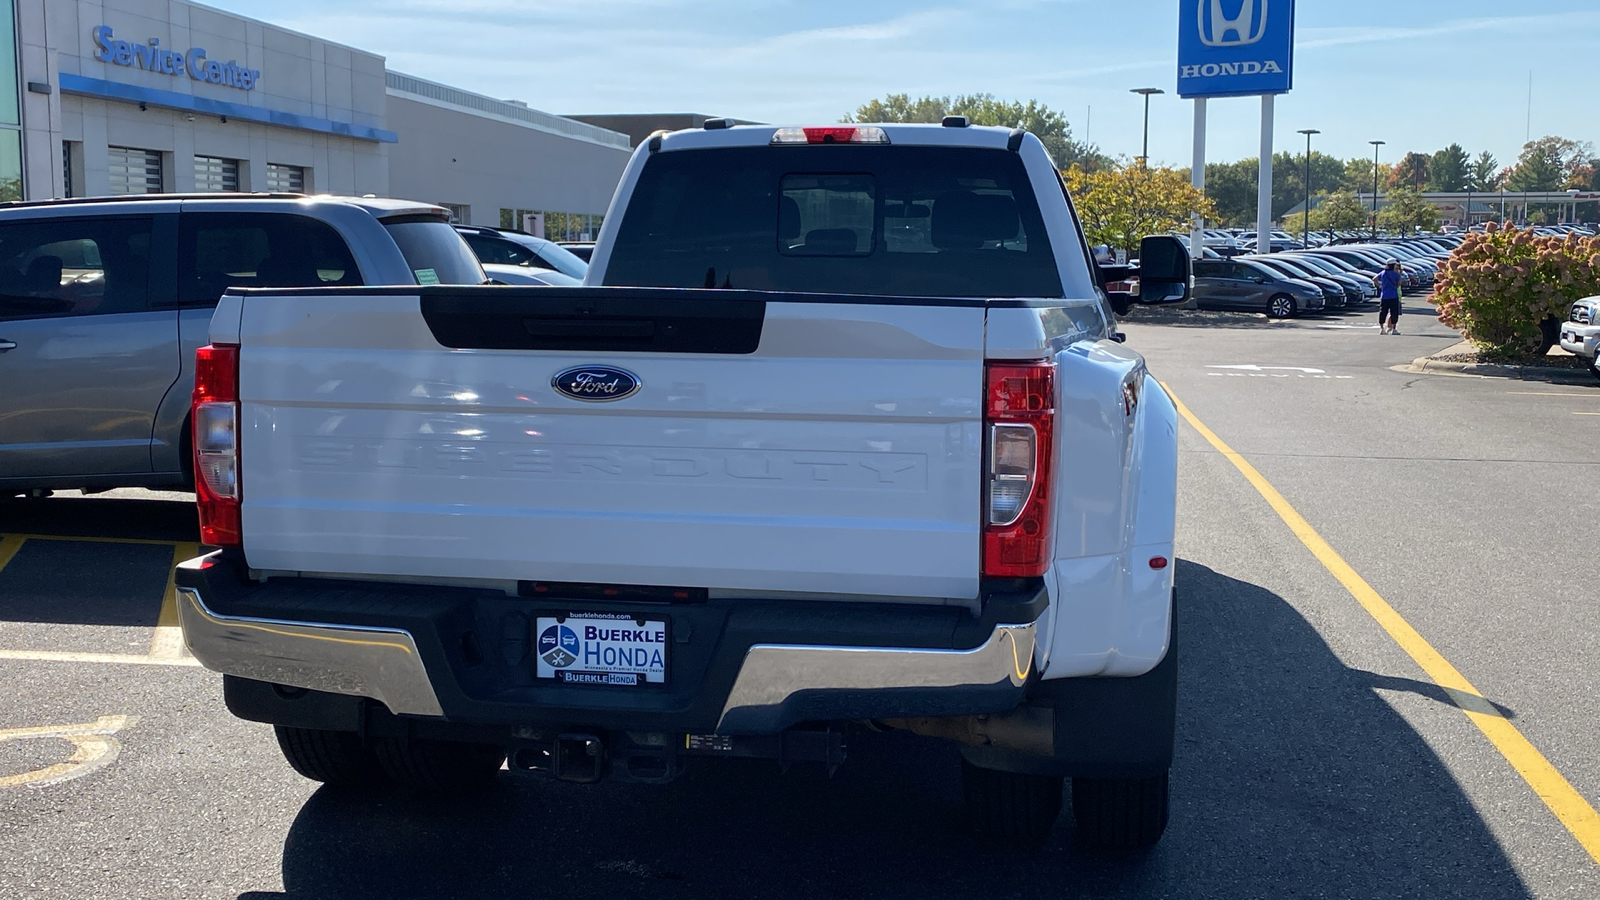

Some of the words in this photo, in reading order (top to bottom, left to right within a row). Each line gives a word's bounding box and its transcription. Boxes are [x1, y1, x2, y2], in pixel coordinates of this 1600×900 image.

[93, 25, 185, 76] Service
[185, 47, 260, 90] Center
[1180, 60, 1283, 78] HONDA
[571, 372, 619, 393] Ford
[299, 445, 621, 476] SUPER
[651, 455, 915, 484] DUTY
[569, 612, 631, 620] buerklehonda.com
[585, 626, 664, 642] BUERKLE
[584, 641, 664, 668] HONDA
[565, 673, 608, 683] BUERKLE
[610, 674, 635, 683] HONDA
